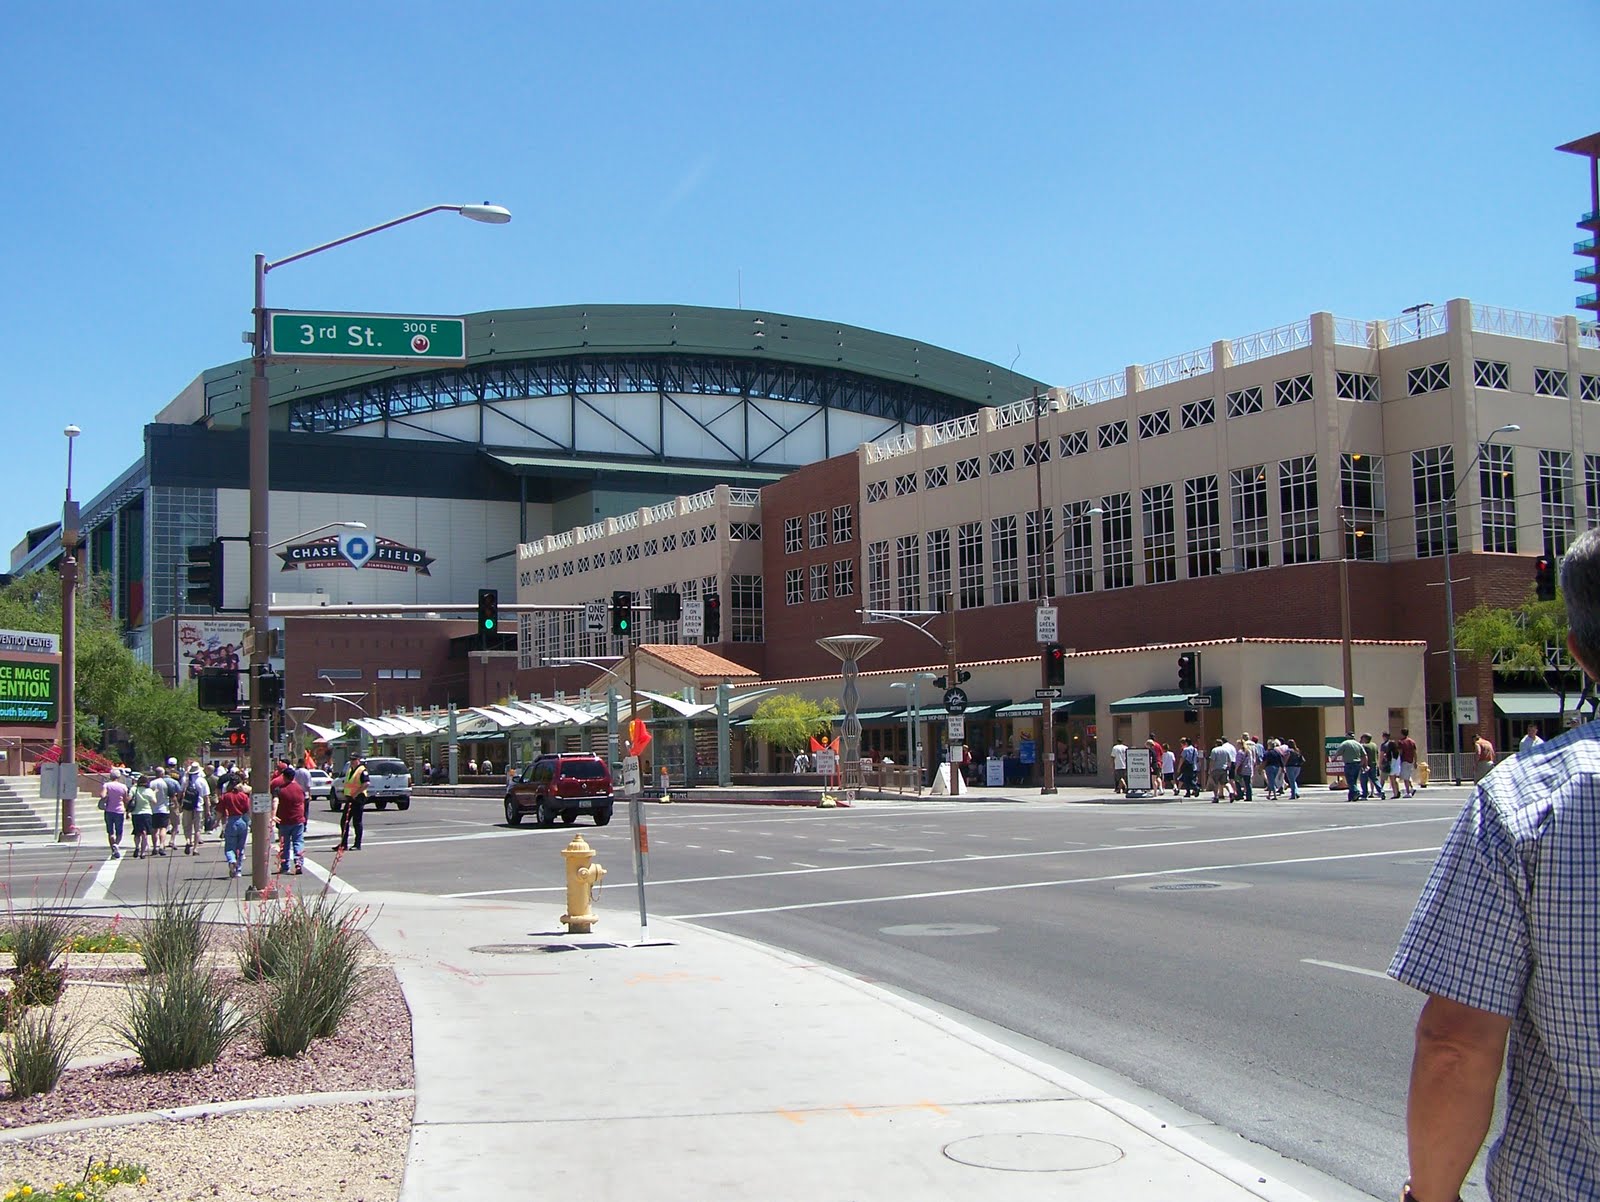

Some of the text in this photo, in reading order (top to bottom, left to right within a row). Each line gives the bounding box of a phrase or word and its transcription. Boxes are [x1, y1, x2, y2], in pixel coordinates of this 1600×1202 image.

[403, 322, 438, 334] 300 E
[300, 323, 383, 348] 3rd St.
[292, 547, 422, 563] CHASE FIELD
[367, 562, 407, 571] DIAMONDBACKS
[588, 605, 605, 614] ONE
[588, 614, 605, 622] WAY
[28, 637, 53, 649] CENTER
[14, 667, 50, 681] MAGIC
[0, 680, 50, 698] ENTION
[18, 707, 48, 720] Building
